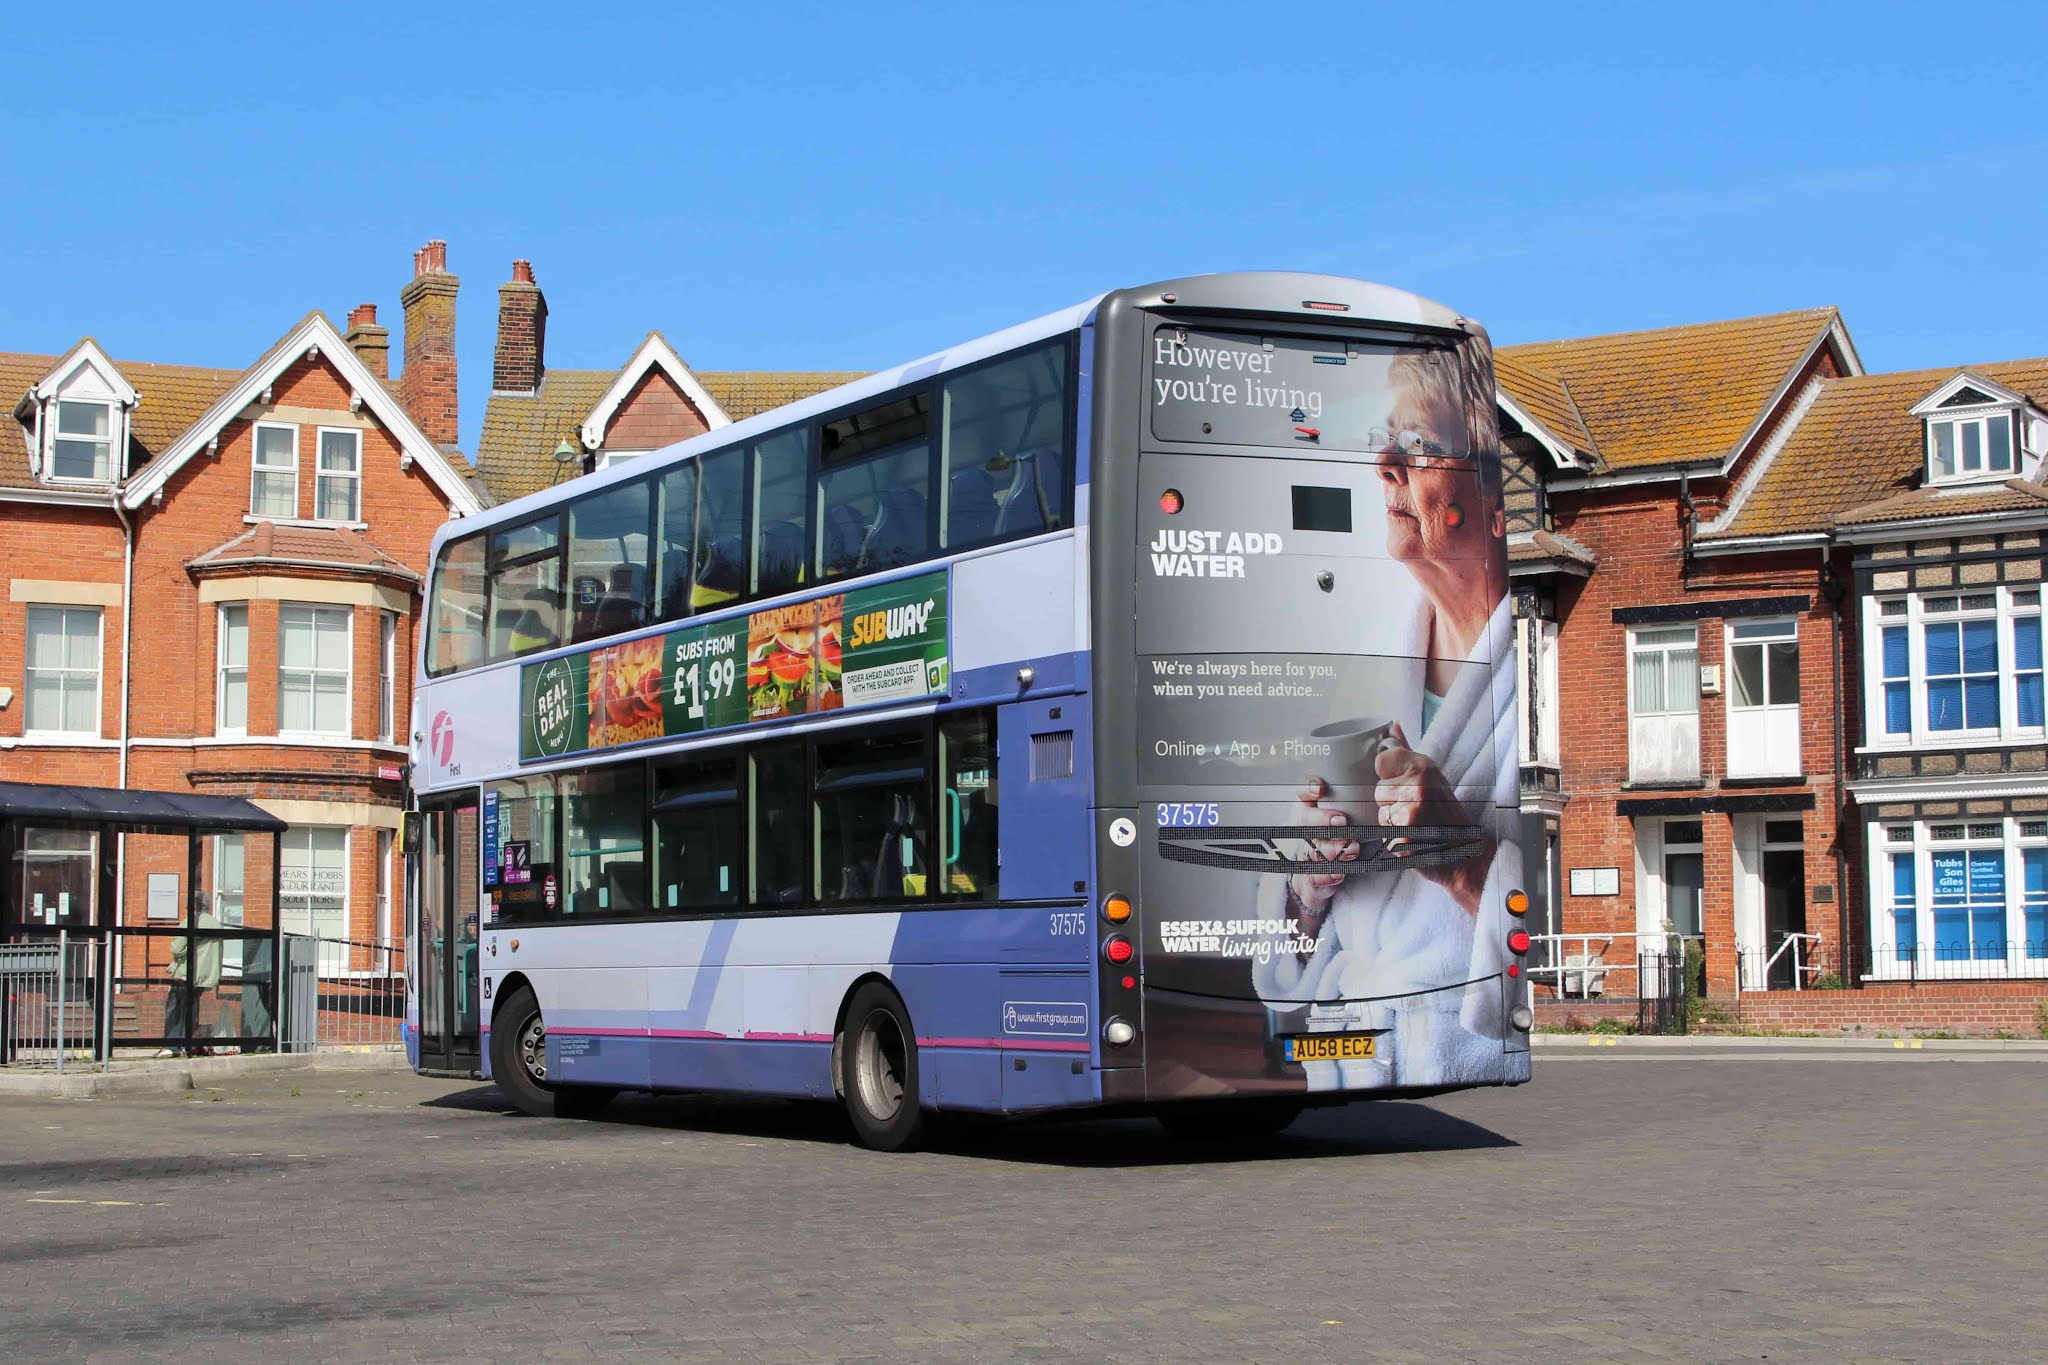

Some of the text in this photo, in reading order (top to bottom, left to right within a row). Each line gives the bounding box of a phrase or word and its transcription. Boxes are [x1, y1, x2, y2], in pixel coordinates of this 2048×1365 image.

[1154, 337, 1275, 374] However
[1155, 374, 1322, 417] you're living
[1151, 529, 1283, 555] JUST ADD
[1151, 553, 1245, 578] WATER
[850, 597, 935, 651] SUBWAY
[676, 634, 736, 662] SUBS FROM
[547, 668, 557, 681] THE
[847, 664, 919, 684] ORDER AHEAD AND COLLECT
[1152, 660, 1337, 679] We're always here for you,
[674, 658, 735, 719] £1.99
[852, 684, 866, 693] WITH
[866, 681, 877, 691] THE
[1153, 681, 1323, 699] when you need advice...
[538, 679, 568, 716] REAL
[550, 730, 564, 748] MENU
[1155, 740, 1331, 760] Online App Phone
[1157, 803, 1219, 825] 37575
[1934, 859, 1963, 868] Tubbs
[1944, 868, 1964, 877] Son
[313, 871, 344, 880] HOBBS
[1939, 877, 1964, 886] Giles
[289, 882, 337, 891] DURRANT
[283, 895, 335, 904] SOLICITORS
[1050, 913, 1085, 935] 37575
[1160, 918, 1299, 937] ESSEX&SUFFOLK
[1161, 933, 1326, 965] WATER living water
[1017, 1011, 1085, 1027] www.firstgroup.com
[1297, 1038, 1373, 1057] AU58 ECZ
